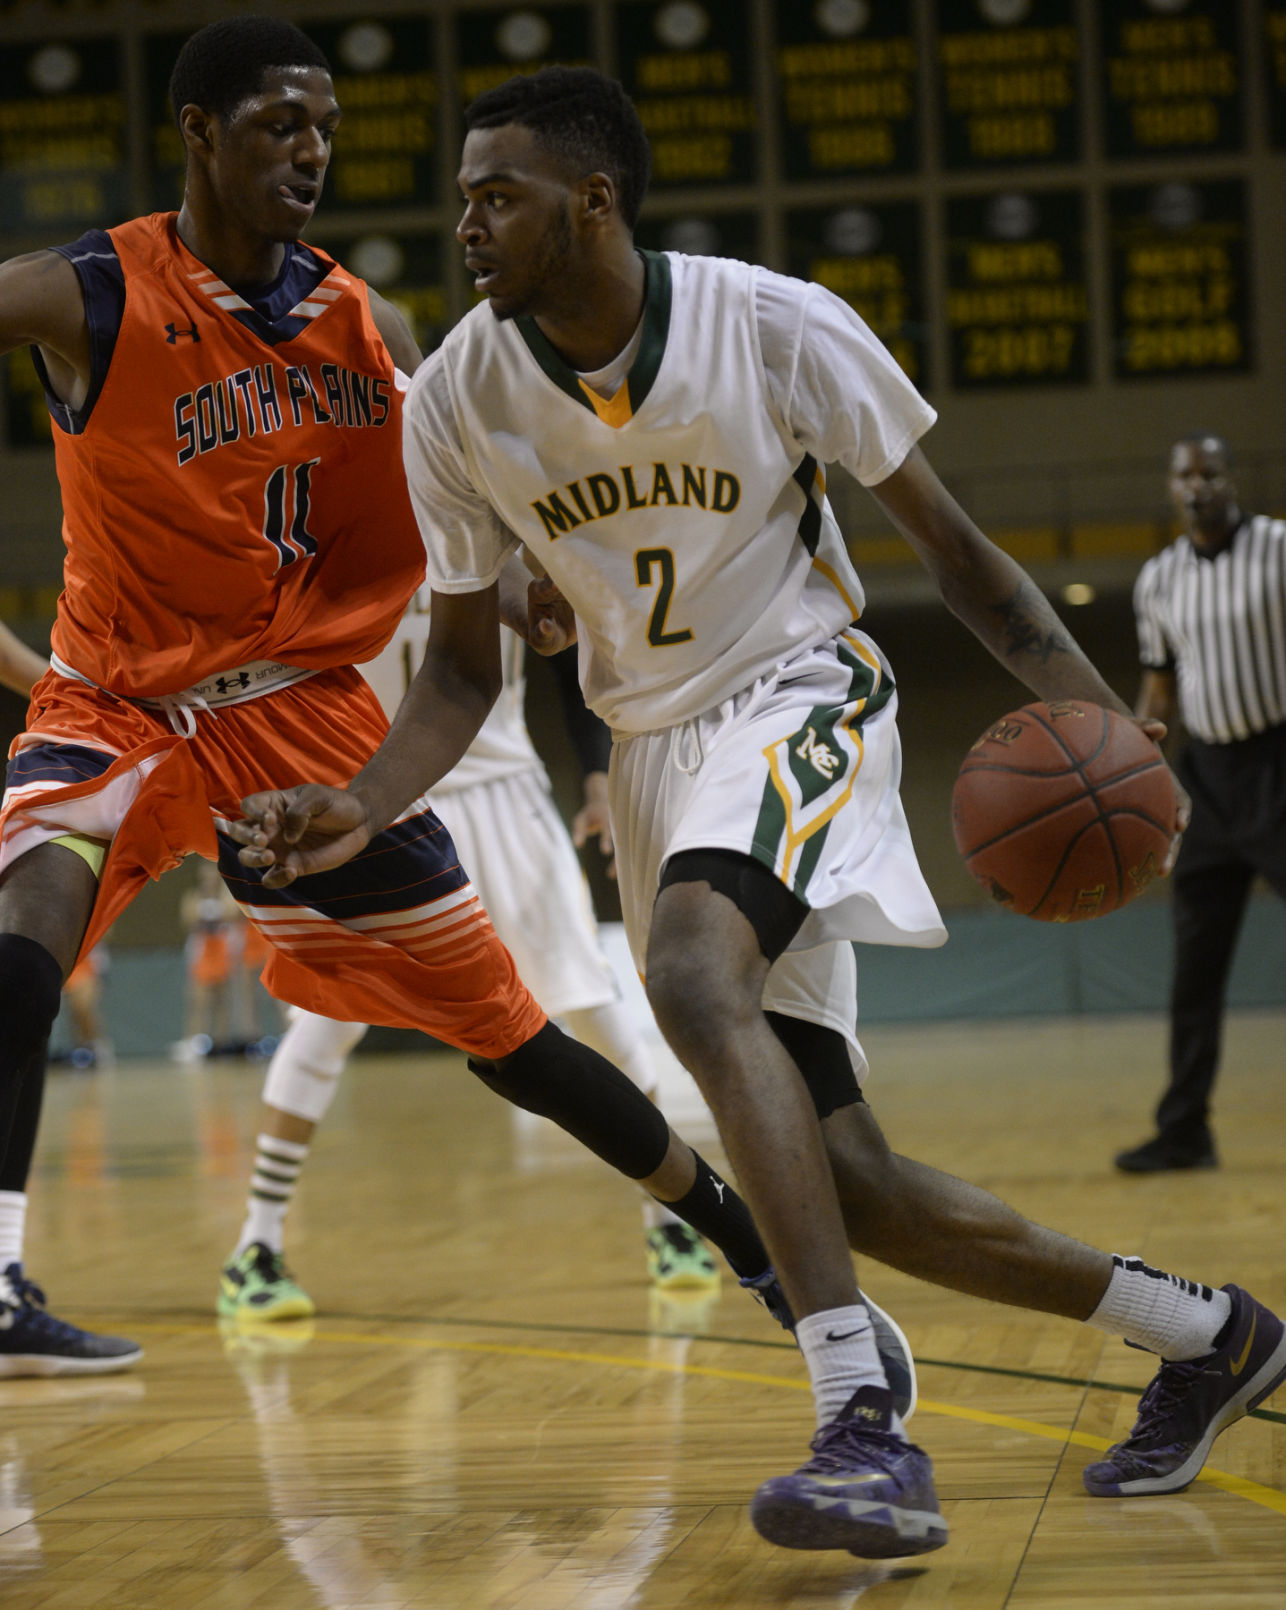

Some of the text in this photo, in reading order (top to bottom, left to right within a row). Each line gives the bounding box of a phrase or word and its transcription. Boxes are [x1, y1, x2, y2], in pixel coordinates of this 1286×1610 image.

[963, 322, 1075, 378] 2007
[173, 362, 391, 468] SOUTH PLAINS
[263, 456, 321, 576] 11
[529, 462, 742, 542] MIDLAND
[633, 546, 695, 649] 2
[255, 664, 291, 680] MOUR
